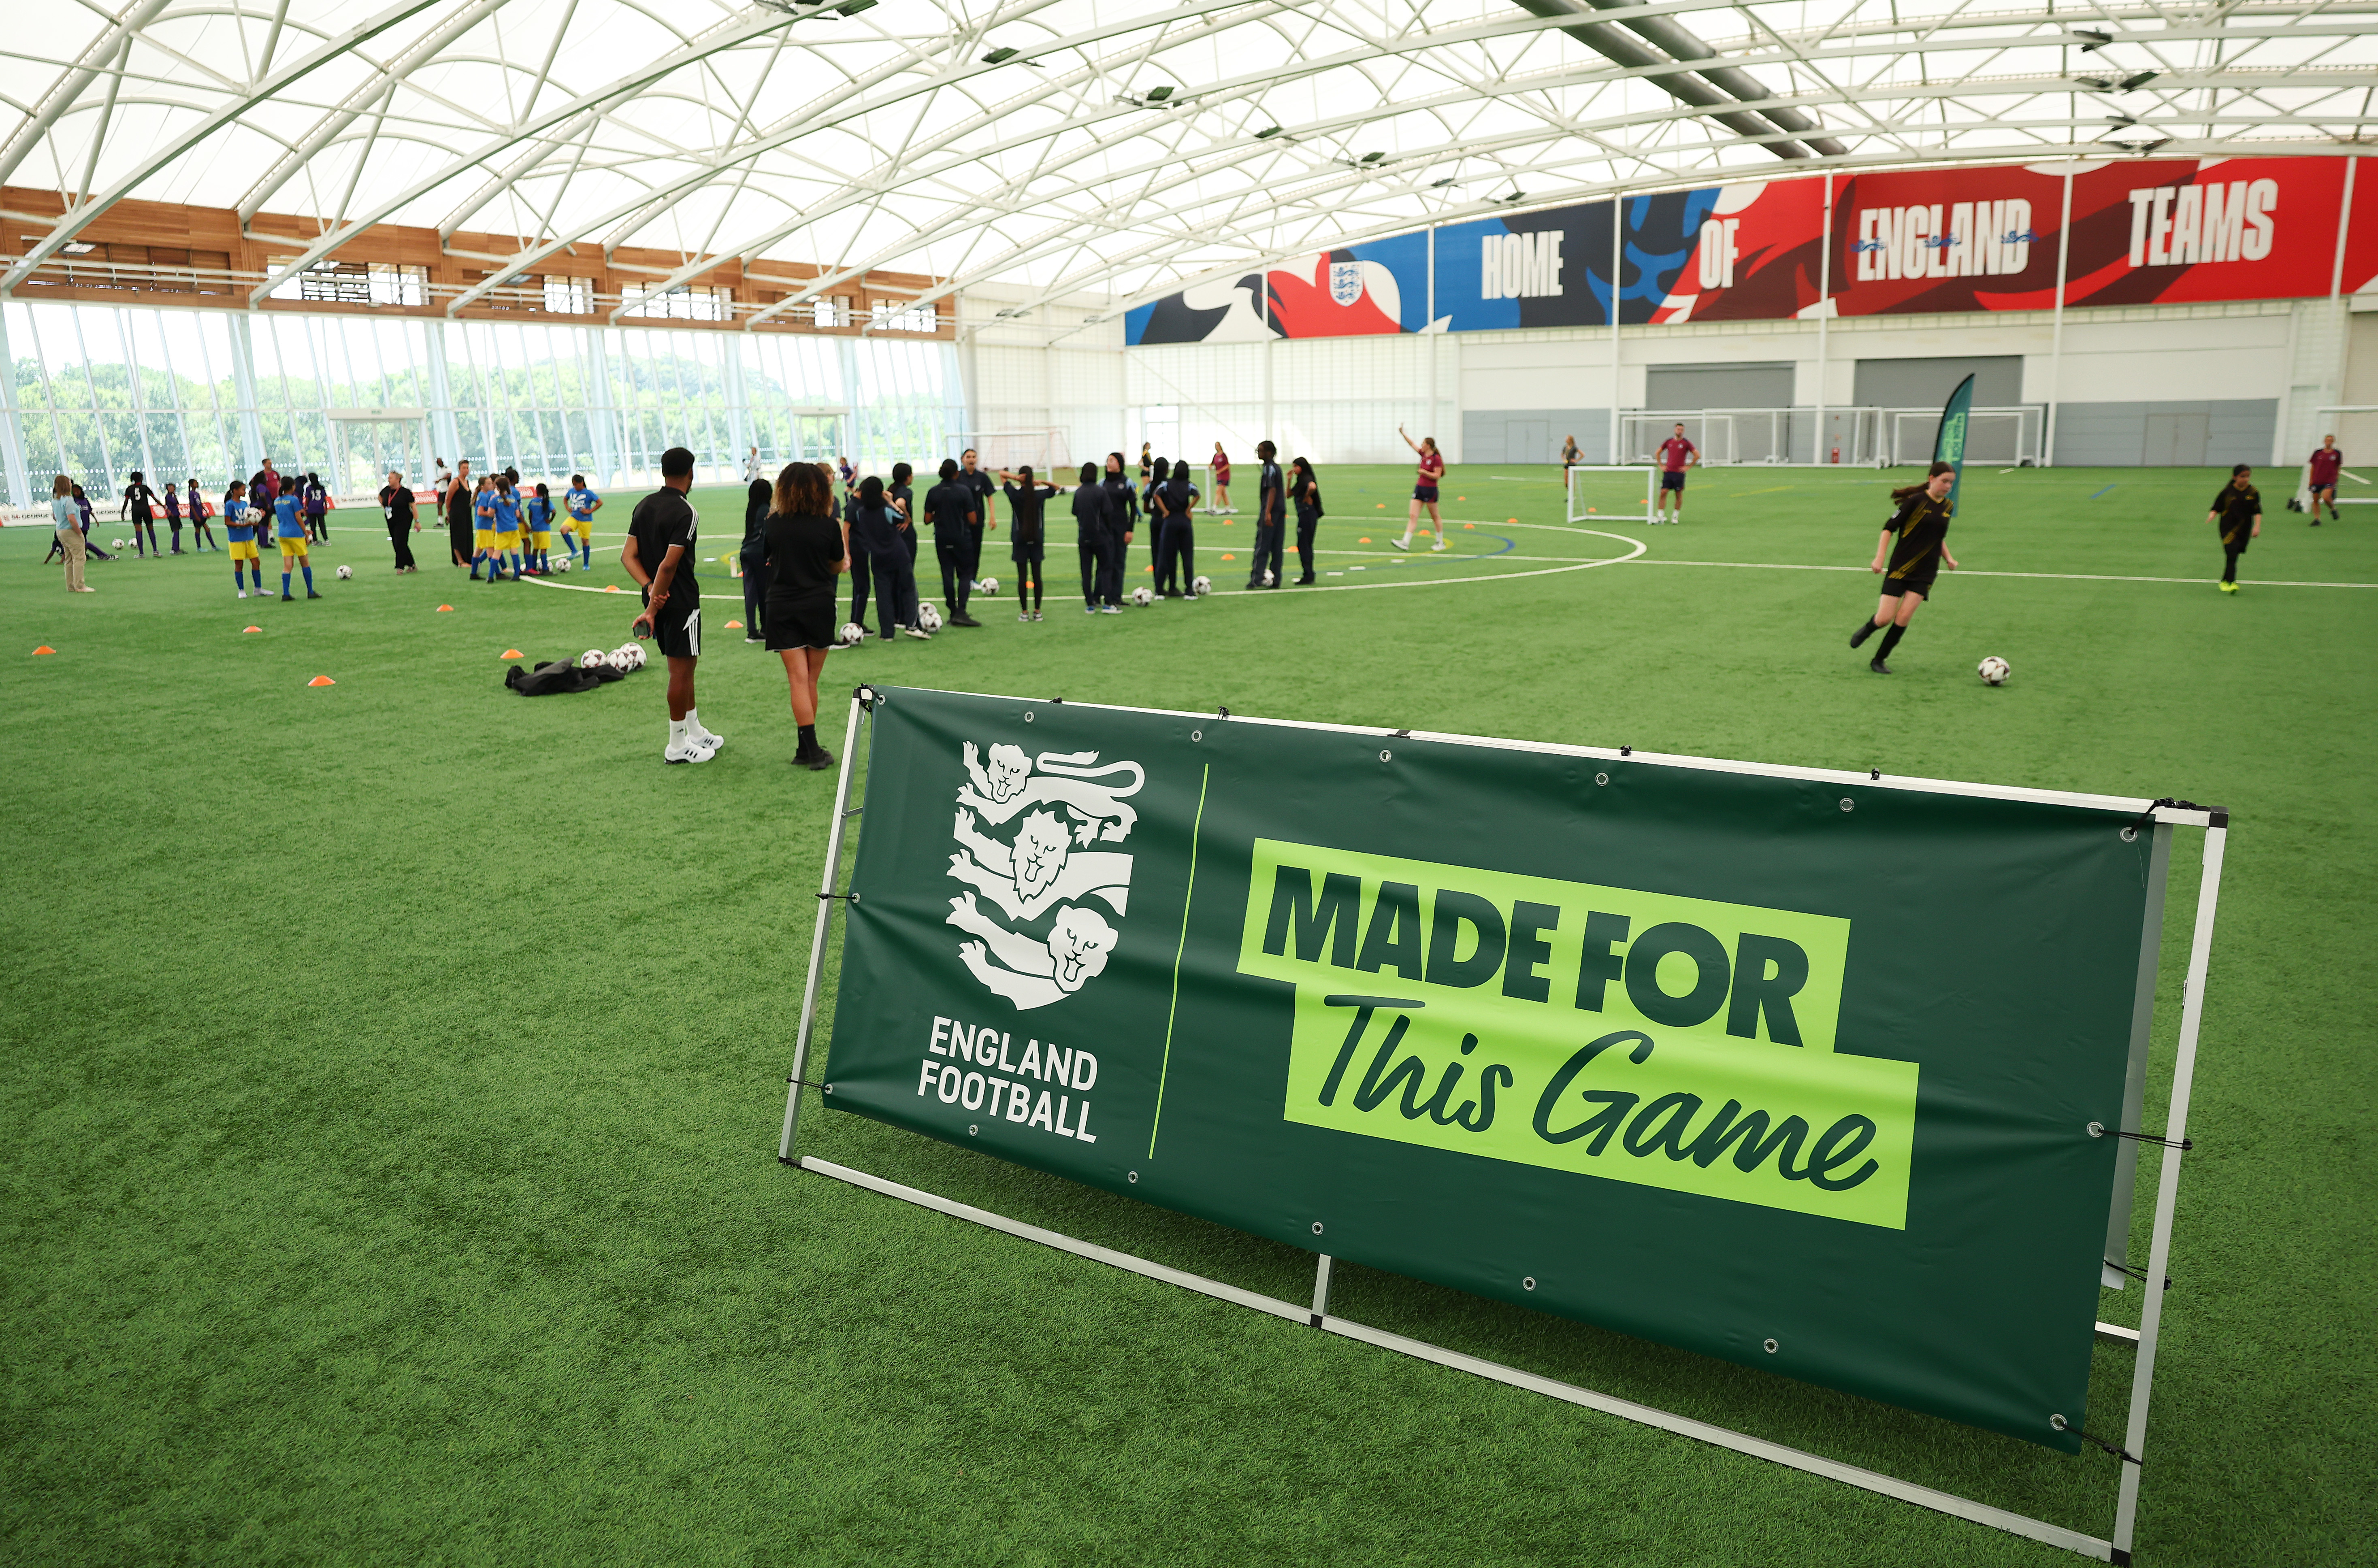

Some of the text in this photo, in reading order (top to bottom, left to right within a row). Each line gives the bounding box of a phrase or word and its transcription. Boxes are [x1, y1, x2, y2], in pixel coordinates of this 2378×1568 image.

[1481, 179, 2279, 300] HOME OF ENGLAND TEAMS
[134, 487, 141, 501] 5
[310, 489, 322, 501] 13
[1262, 864, 1809, 1048] MADE FOR
[929, 1015, 1098, 1091] ENGLAND
[1318, 994, 1879, 1191] This Game
[918, 1060, 1097, 1144] FOOTBALL
